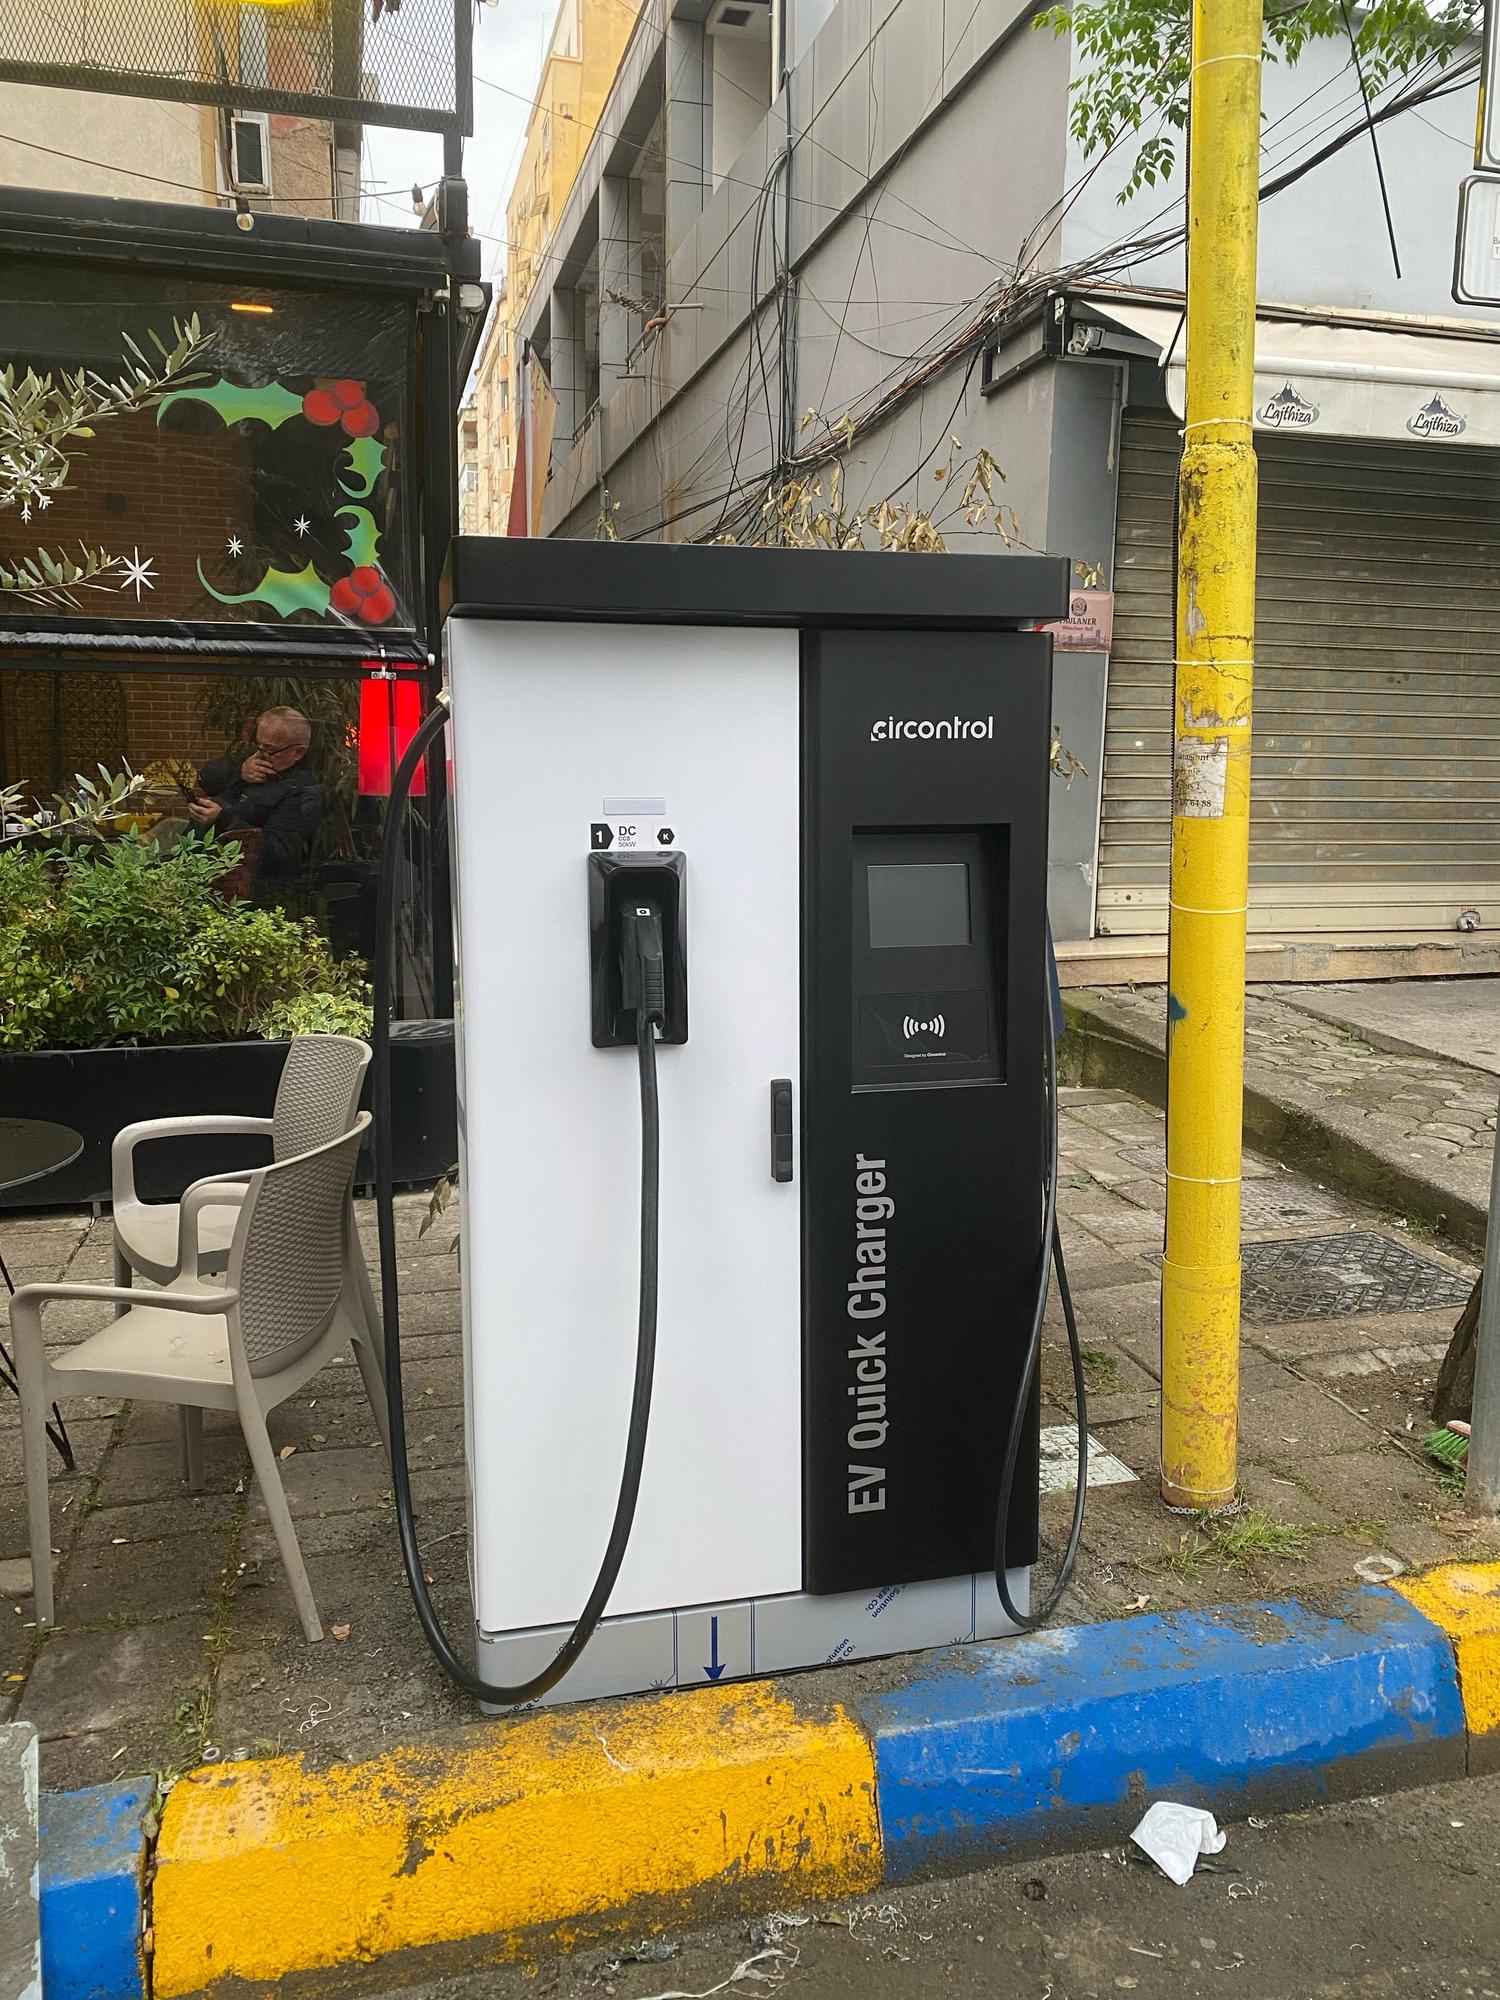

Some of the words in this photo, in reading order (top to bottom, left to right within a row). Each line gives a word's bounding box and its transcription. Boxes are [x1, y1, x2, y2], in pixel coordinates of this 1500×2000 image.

[1263, 403, 1312, 428] Lajthiza
[1413, 414, 1459, 437] Lajthiza
[870, 716, 994, 741] circontrol
[596, 830, 603, 844] 1
[619, 826, 636, 836] DC
[662, 833, 669, 841] K
[847, 1153, 895, 1320] Charger
[848, 1331, 890, 1450] Quick
[848, 1464, 886, 1514] EV
[825, 1638, 849, 1664] olution
